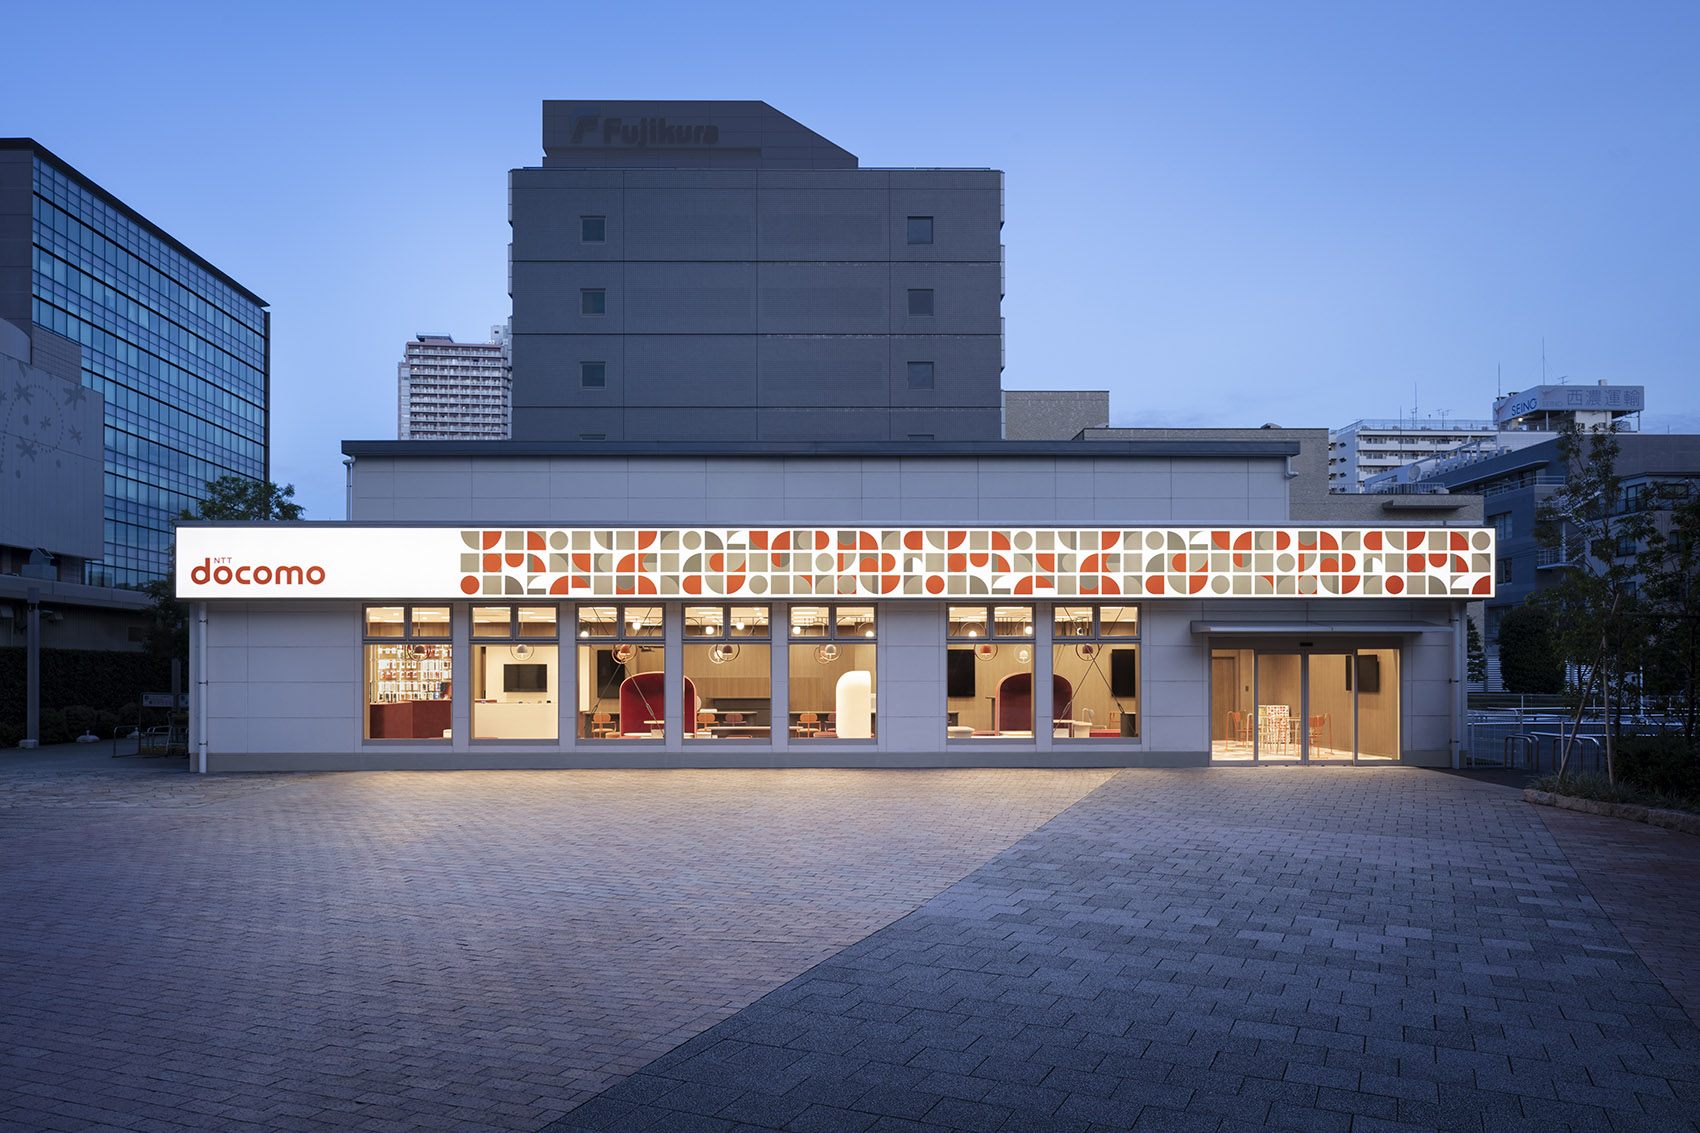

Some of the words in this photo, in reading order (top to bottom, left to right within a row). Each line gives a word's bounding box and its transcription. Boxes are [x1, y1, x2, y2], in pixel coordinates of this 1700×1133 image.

[1511, 397, 1538, 417] SEINO
[1567, 389, 1641, 407] 西濃運輸
[190, 557, 326, 585] docomo
